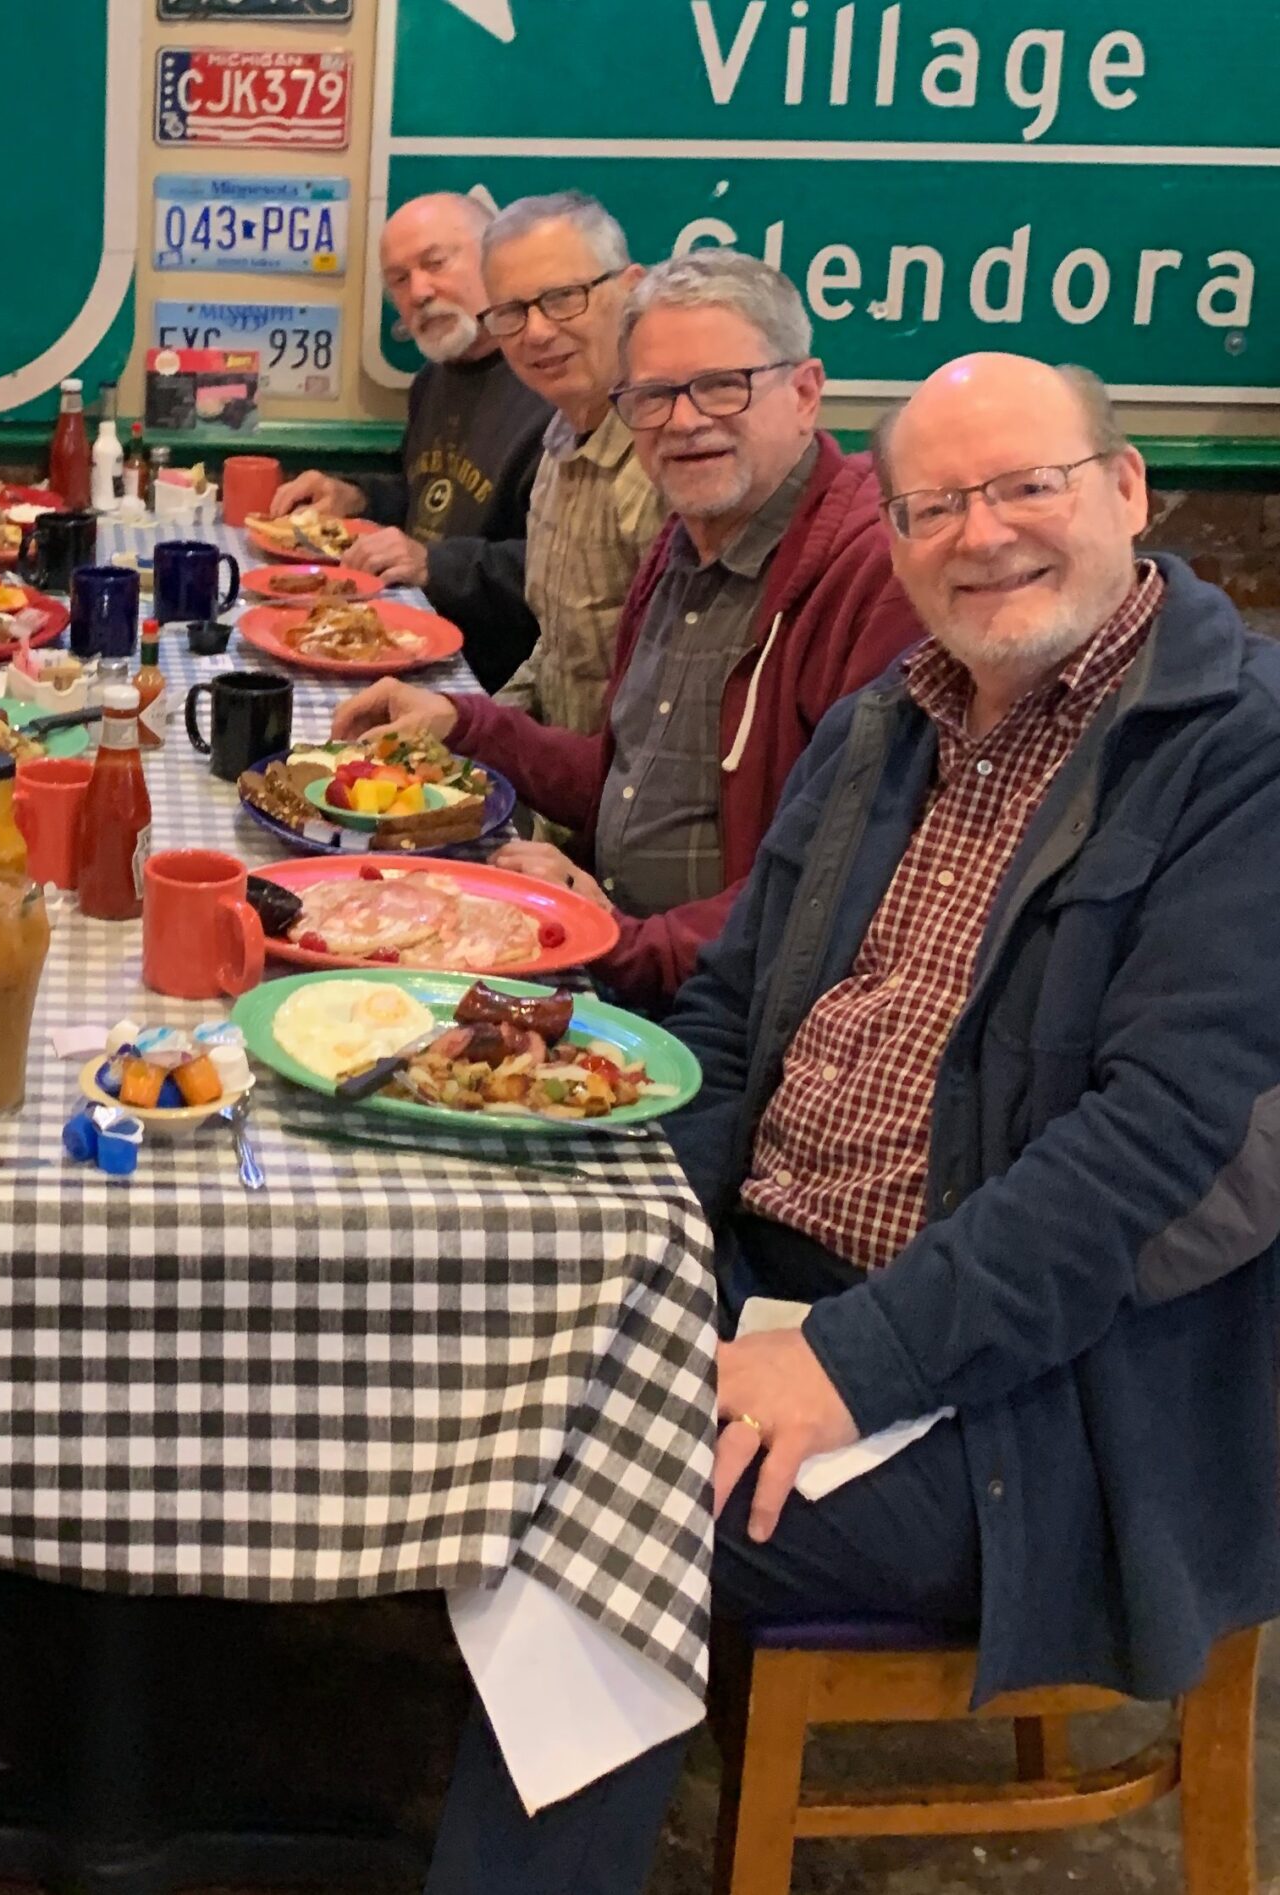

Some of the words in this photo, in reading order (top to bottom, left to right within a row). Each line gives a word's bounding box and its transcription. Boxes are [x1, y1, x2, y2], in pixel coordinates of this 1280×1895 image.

[177, 68, 344, 115] CJK379
[690, 0, 1145, 142] Village
[165, 205, 237, 251] 043
[261, 206, 334, 253] PGA
[268, 328, 333, 370] 938
